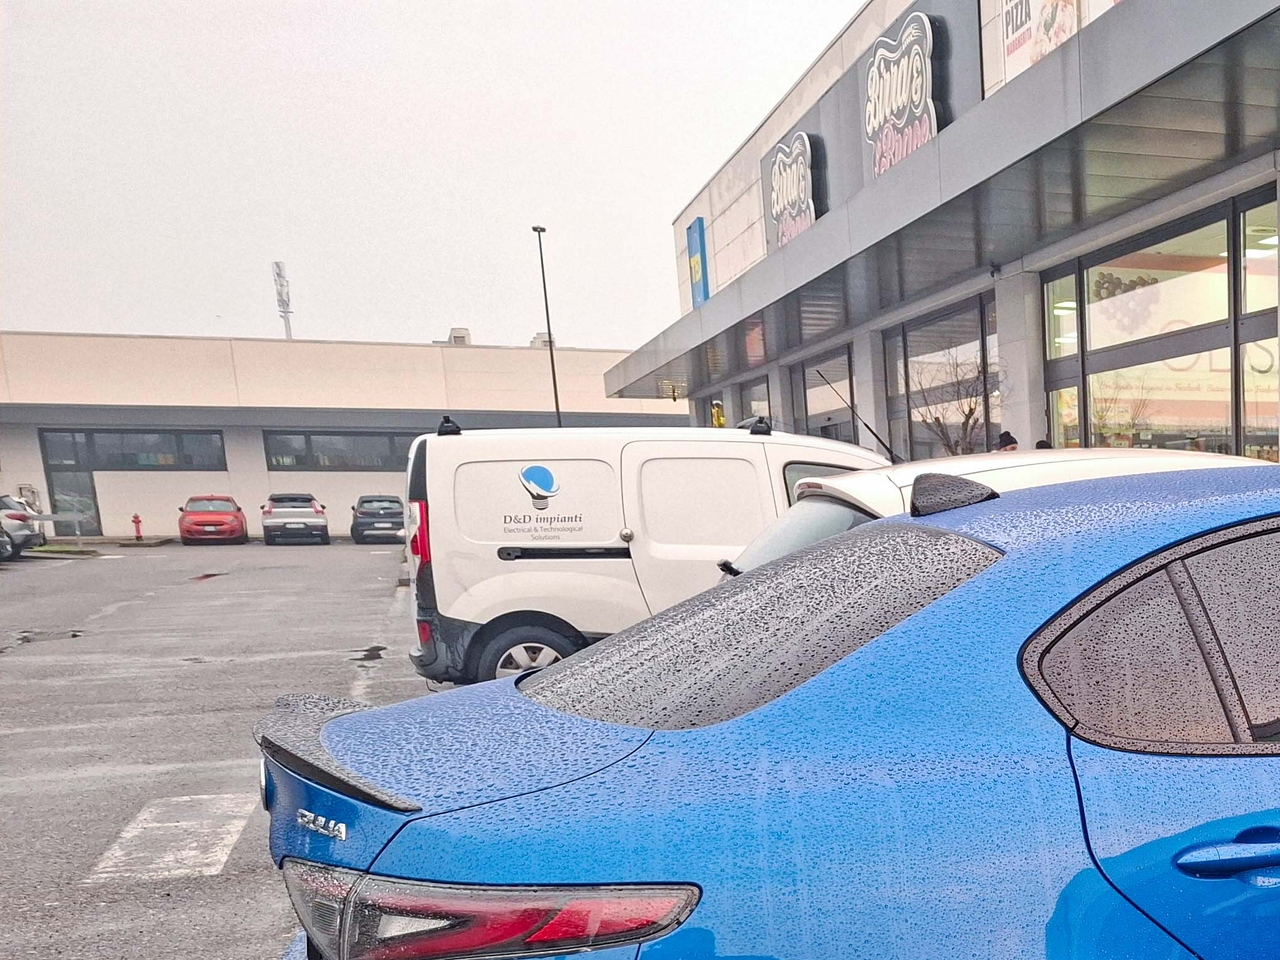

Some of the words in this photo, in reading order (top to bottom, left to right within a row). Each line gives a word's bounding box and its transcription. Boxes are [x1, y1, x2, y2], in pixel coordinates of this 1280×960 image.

[1005, 0, 1031, 40] PIZZA
[503, 514, 532, 524] D&D
[535, 513, 583, 526] impianti
[503, 526, 532, 534] Electrical
[540, 525, 583, 533] Technological
